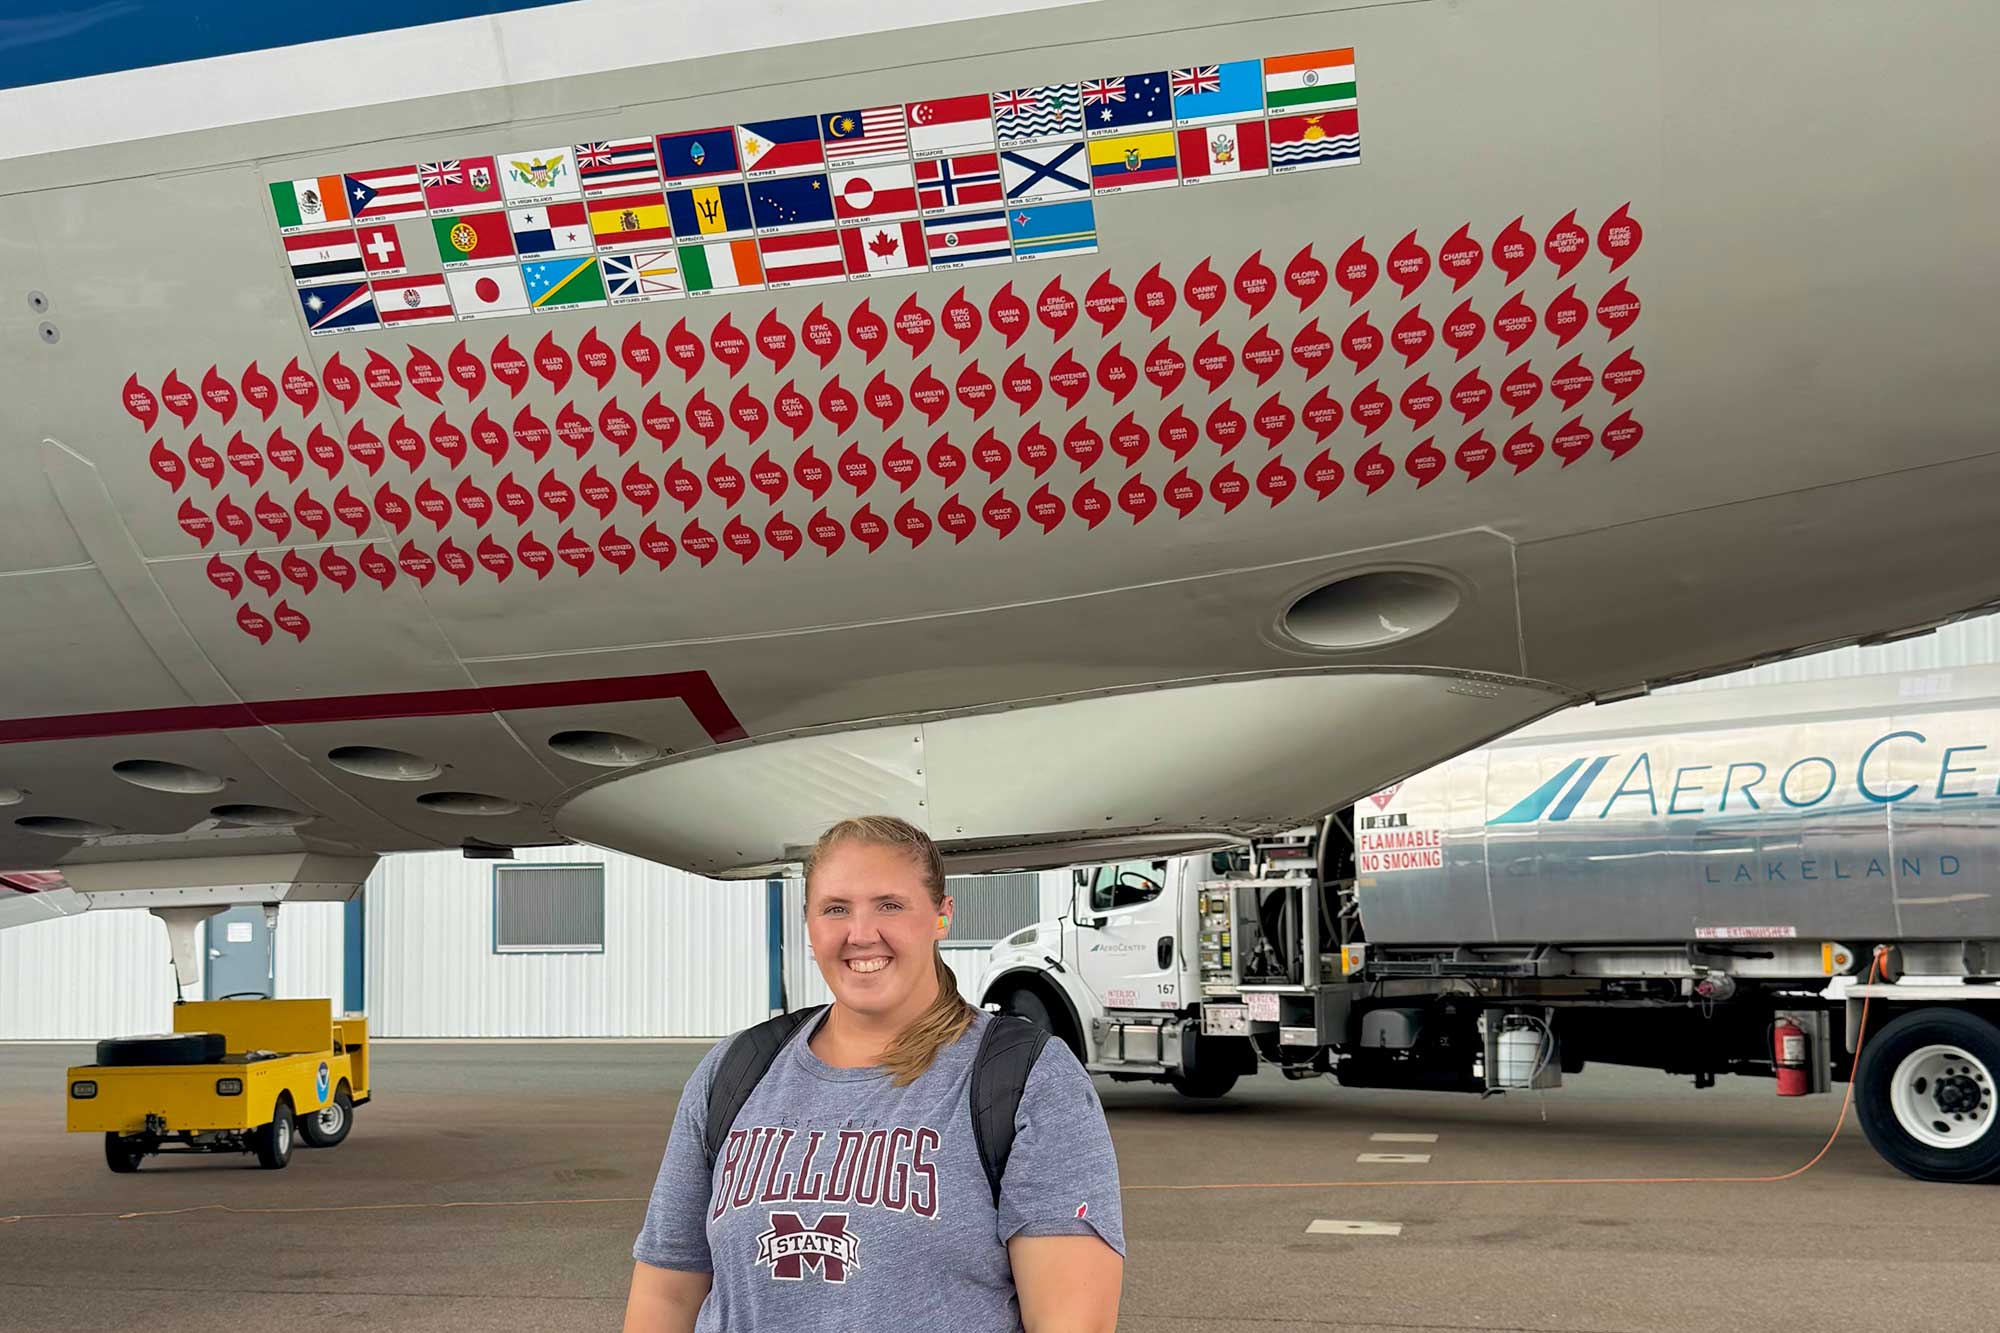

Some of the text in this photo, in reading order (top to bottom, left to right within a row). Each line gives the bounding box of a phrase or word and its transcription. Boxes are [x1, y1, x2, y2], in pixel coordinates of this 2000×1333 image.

[1091, 128, 1118, 136] AUSTRALIA
[1609, 226, 1630, 235] EPAC
[1556, 231, 1577, 240] EPAC
[1608, 232, 1631, 241] PAINE
[1549, 237, 1585, 248] NEWTON
[1610, 238, 1630, 247] 1986
[1503, 243, 1524, 253] EARL
[1557, 244, 1577, 253] 1986
[1442, 250, 1479, 261] CHARLEY
[1504, 250, 1524, 259] 1986
[1393, 257, 1423, 268] BONNIE
[1452, 258, 1471, 267] 1986
[1346, 264, 1367, 273] JUAN
[1399, 264, 1419, 274] 1986
[1291, 270, 1320, 280] GLORIA
[1347, 270, 1367, 279] 1985
[1242, 278, 1268, 288] ELENA
[1297, 277, 1316, 286] 1985
[1192, 285, 1218, 295] DANNY
[1247, 285, 1265, 294] 1985
[1146, 291, 1164, 300] BOB
[1197, 291, 1216, 300] 1985
[1046, 296, 1066, 305] EPAC
[1086, 296, 1126, 307] JOSEPHINE
[1147, 298, 1165, 307] 1985
[1039, 301, 1074, 312] NORBERT
[1097, 304, 1115, 313] 1984
[1597, 303, 1639, 314] GABRIELLE
[950, 307, 969, 317] EPAC
[997, 308, 1020, 317] DIANA
[1049, 309, 1068, 318] 1984
[1557, 310, 1576, 318] ERIN
[903, 313, 922, 322] EPAC
[951, 314, 970, 323] TICO
[1001, 315, 1019, 324] 1984
[1498, 316, 1532, 326] MICHAEL
[896, 319, 932, 329] RAYMOND
[953, 321, 971, 330] 1983
[1450, 323, 1476, 332] FLOYD
[856, 325, 879, 334] ALICIA
[906, 326, 924, 334] 1983
[860, 331, 878, 340] 1983
[1398, 329, 1427, 340] DENNIS
[1351, 336, 1372, 345] BRET
[1293, 343, 1331, 353] GEORGES
[1599, 731, 2000, 819] AEROCE
[1361, 830, 1440, 851] FLAMMABLE
[1362, 850, 1441, 871] NO SMOKING
[1706, 855, 1961, 883] LAKELAND
[1157, 984, 1175, 994] 167
[712, 1126, 940, 1224] BULLDOGS
[776, 1235, 843, 1258] STATE
